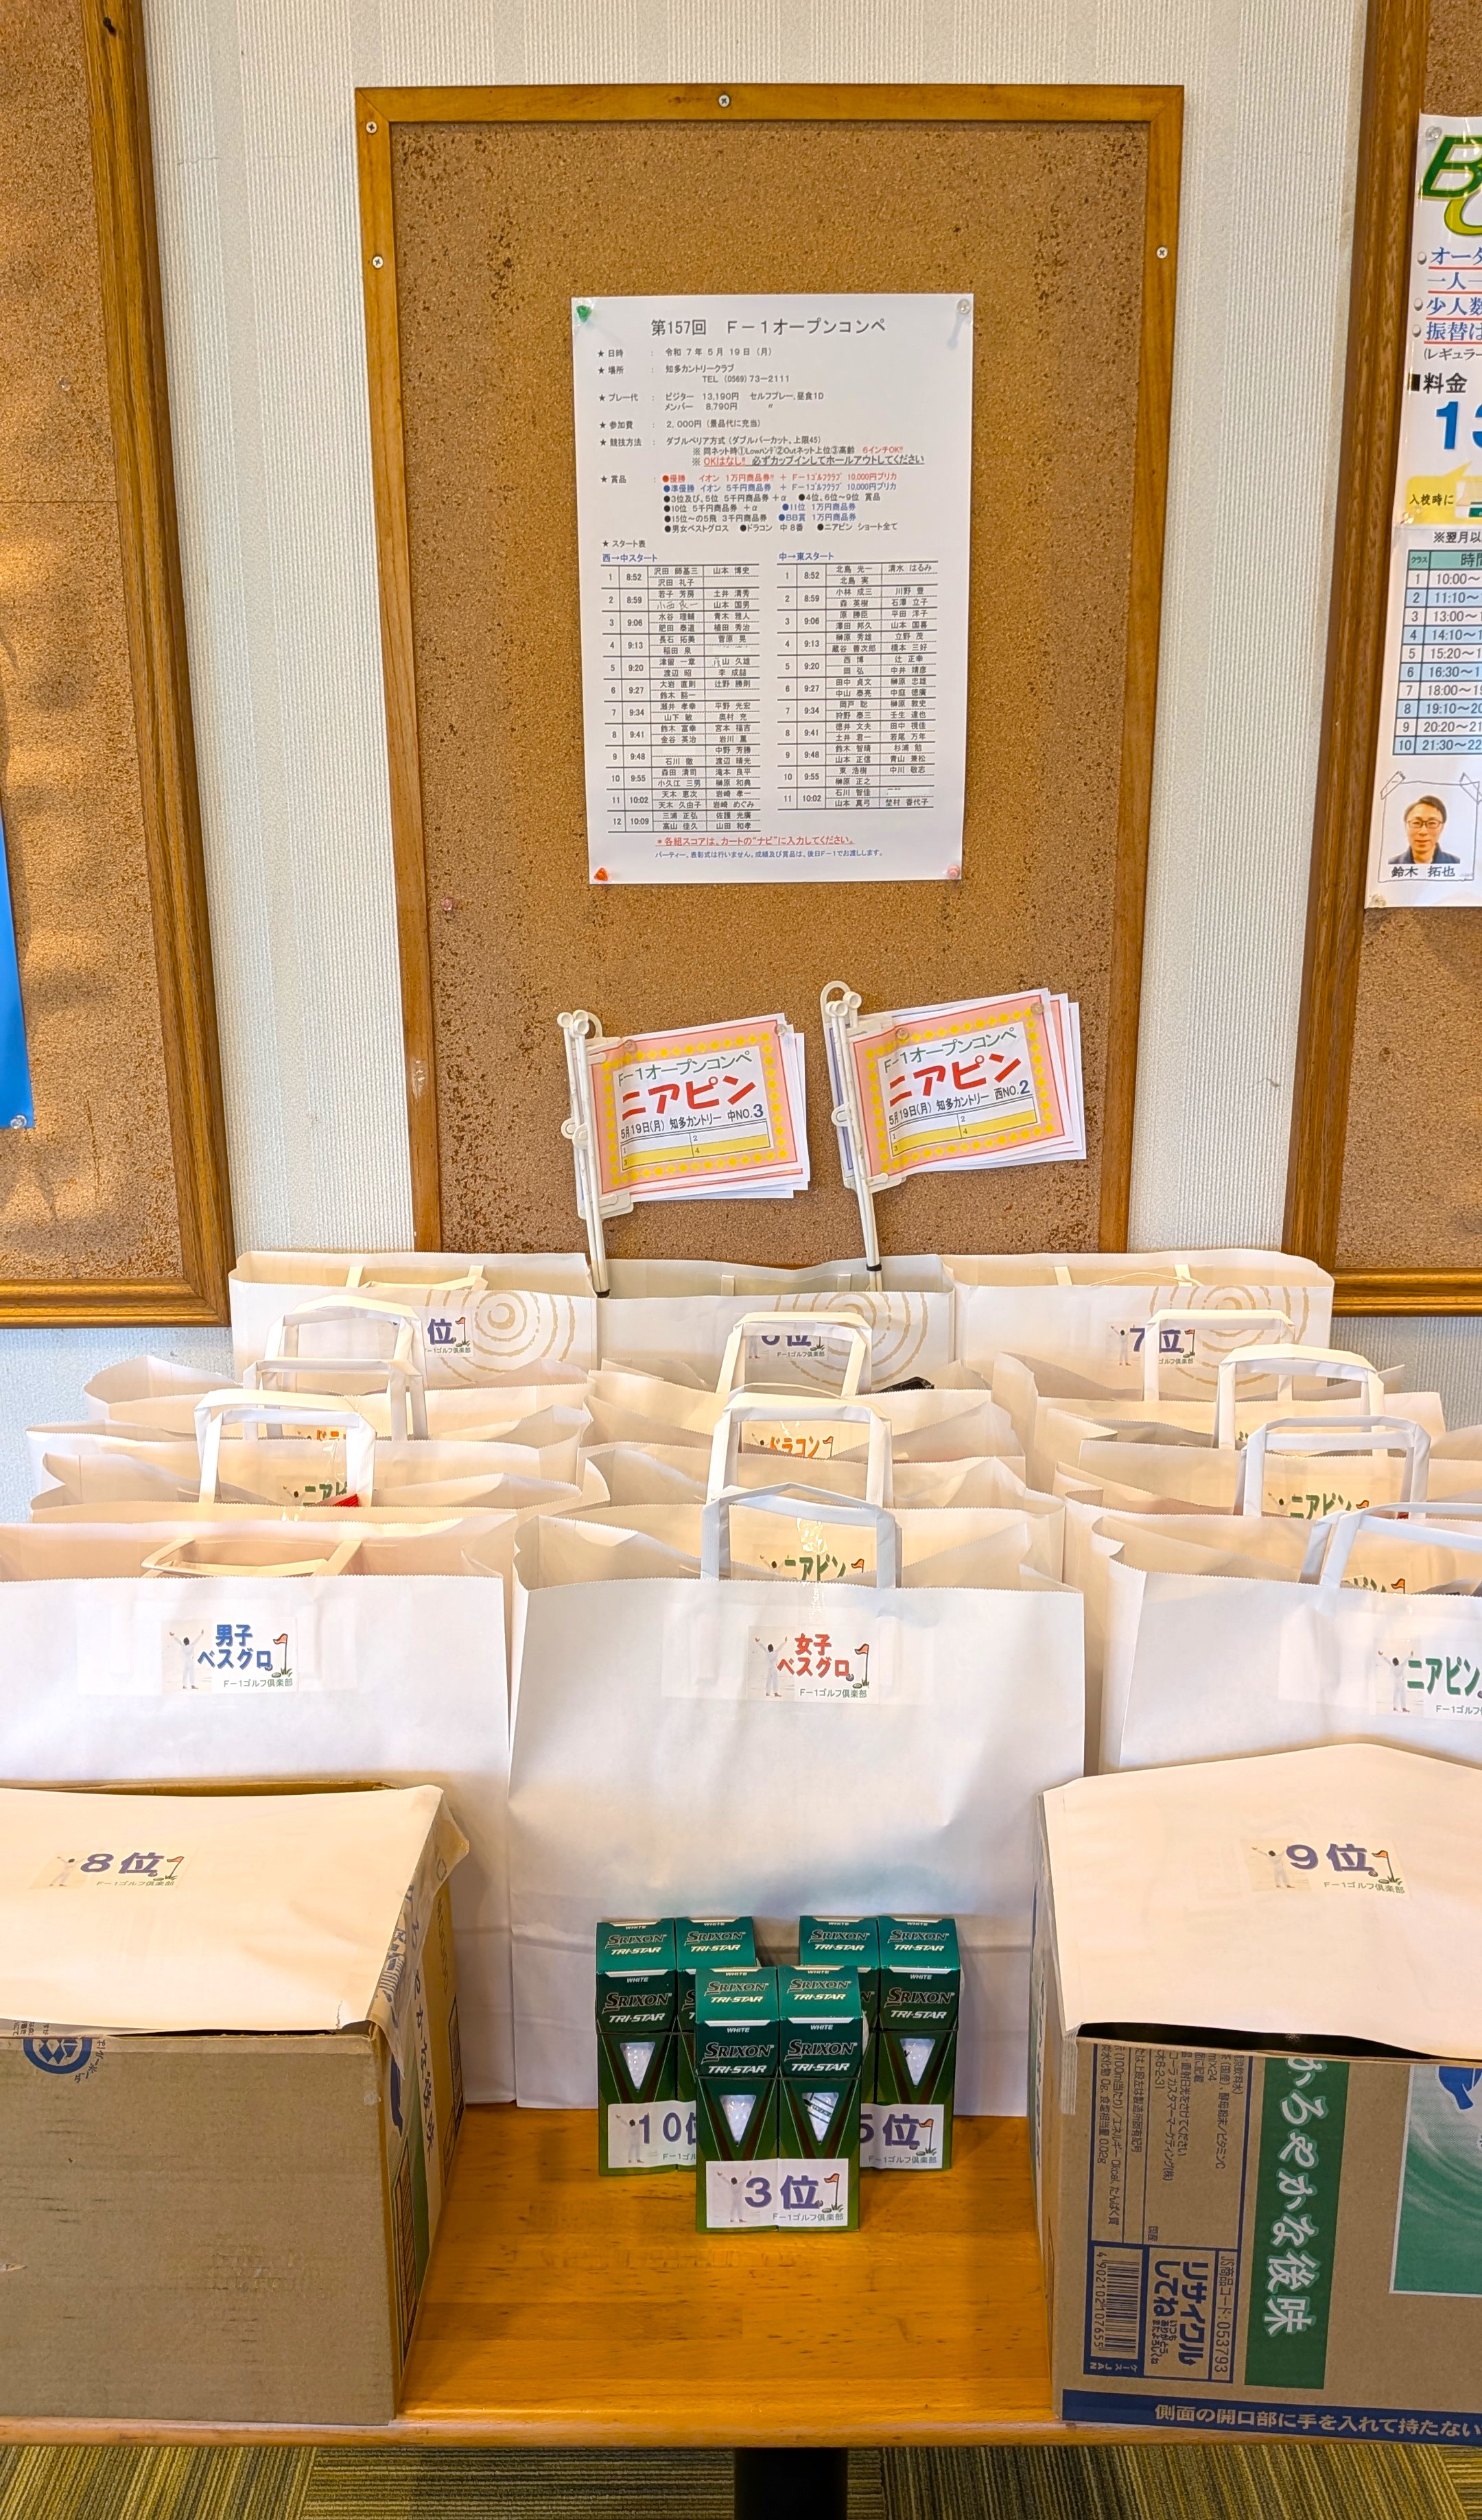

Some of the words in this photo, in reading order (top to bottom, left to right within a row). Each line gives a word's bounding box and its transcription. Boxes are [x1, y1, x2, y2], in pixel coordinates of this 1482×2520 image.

[651, 319, 706, 336] 第157回
[608, 349, 624, 357] 日時
[666, 348, 681, 356] 令和
[666, 364, 734, 373] 知多カントリークラブ
[1423, 373, 1468, 394] 料金
[609, 393, 638, 402] プレー代
[706, 403, 737, 411] 8,790円
[610, 421, 633, 429] 参加費
[610, 438, 642, 447] 競技方法
[611, 475, 626, 484] 賞品
[727, 484, 771, 492] 5千円商品券
[865, 493, 880, 501] 賞品
[1409, 494, 1454, 506] 入校時に
[692, 504, 737, 513] 5千円商品券
[722, 514, 767, 522] 3千円商品券
[672, 524, 729, 532] 男女ベストグロス
[858, 522, 897, 530] ショート全て
[612, 539, 646, 548] スタート表
[1416, 574, 1420, 585] 1
[1413, 592, 1420, 603] 2
[1411, 611, 1418, 622] 3
[1410, 630, 1416, 640] 4
[1409, 648, 1415, 659] 5
[1407, 667, 1414, 677] 6
[1430, 667, 1482, 677] 16:30～1
[1407, 685, 1413, 696] 7
[1404, 703, 1411, 714] 8
[1402, 722, 1409, 732] 9
[1399, 740, 1411, 751] 10
[1391, 866, 1419, 878] 鈴木
[1427, 866, 1455, 878] 拓也
[884, 1027, 1017, 1073] F-1オープンコンペ
[618, 1050, 752, 1087] F-1オープンコンペ
[890, 1053, 1022, 1107] ニアピン
[622, 1075, 756, 1121] ニアピン
[937, 1092, 989, 1111] 知多カントリー
[670, 1114, 721, 1130] 知多カントリー
[215, 1624, 253, 1647] 男子
[795, 1633, 832, 1656] 女子
[198, 1648, 271, 1670] ベスグロ
[777, 1657, 849, 1678] ベスグロ
[1407, 1656, 1480, 1697] ニアピン
[224, 1678, 292, 1687] F-1ゴルフ倶楽部
[800, 1689, 867, 1698] F-1ゴルフ倶楽部
[604, 1934, 664, 1949] SRIXON
[684, 1931, 743, 1946] SRIXON
[808, 1929, 867, 1943] SRIXON
[887, 1929, 947, 1944] SRIXON
[611, 1946, 661, 1955] TRI-STAR
[690, 1944, 741, 1953] TRI-STAR
[704, 1981, 766, 1997] SRIXON
[787, 1979, 848, 1994] SRIXON
[602, 1992, 670, 2014] SRIXON
[884, 1987, 952, 2009] SRIXON
[609, 2013, 666, 2023] TRI-STAR
[891, 2010, 947, 2019] TRI-STAR
[701, 2042, 771, 2065] SRIXON
[784, 2039, 855, 2062] SRIXON
[708, 2065, 767, 2074] TRI-STAR
[791, 2063, 850, 2071] TRI-STAR
[869, 2156, 937, 2164] F-1ゴルフ倶楽部
[744, 2175, 819, 2210] 3位
[773, 2213, 843, 2222] F-1ゴルフ倶楽部
[1147, 2226, 1159, 2241] 国産
[1153, 2260, 1179, 2316] してね
[1178, 2261, 1209, 2366] リサイクル
[1169, 2320, 1177, 2341] いつも
[1154, 2403, 1482, 2438] 側面の開口部に手を入れて持たない
